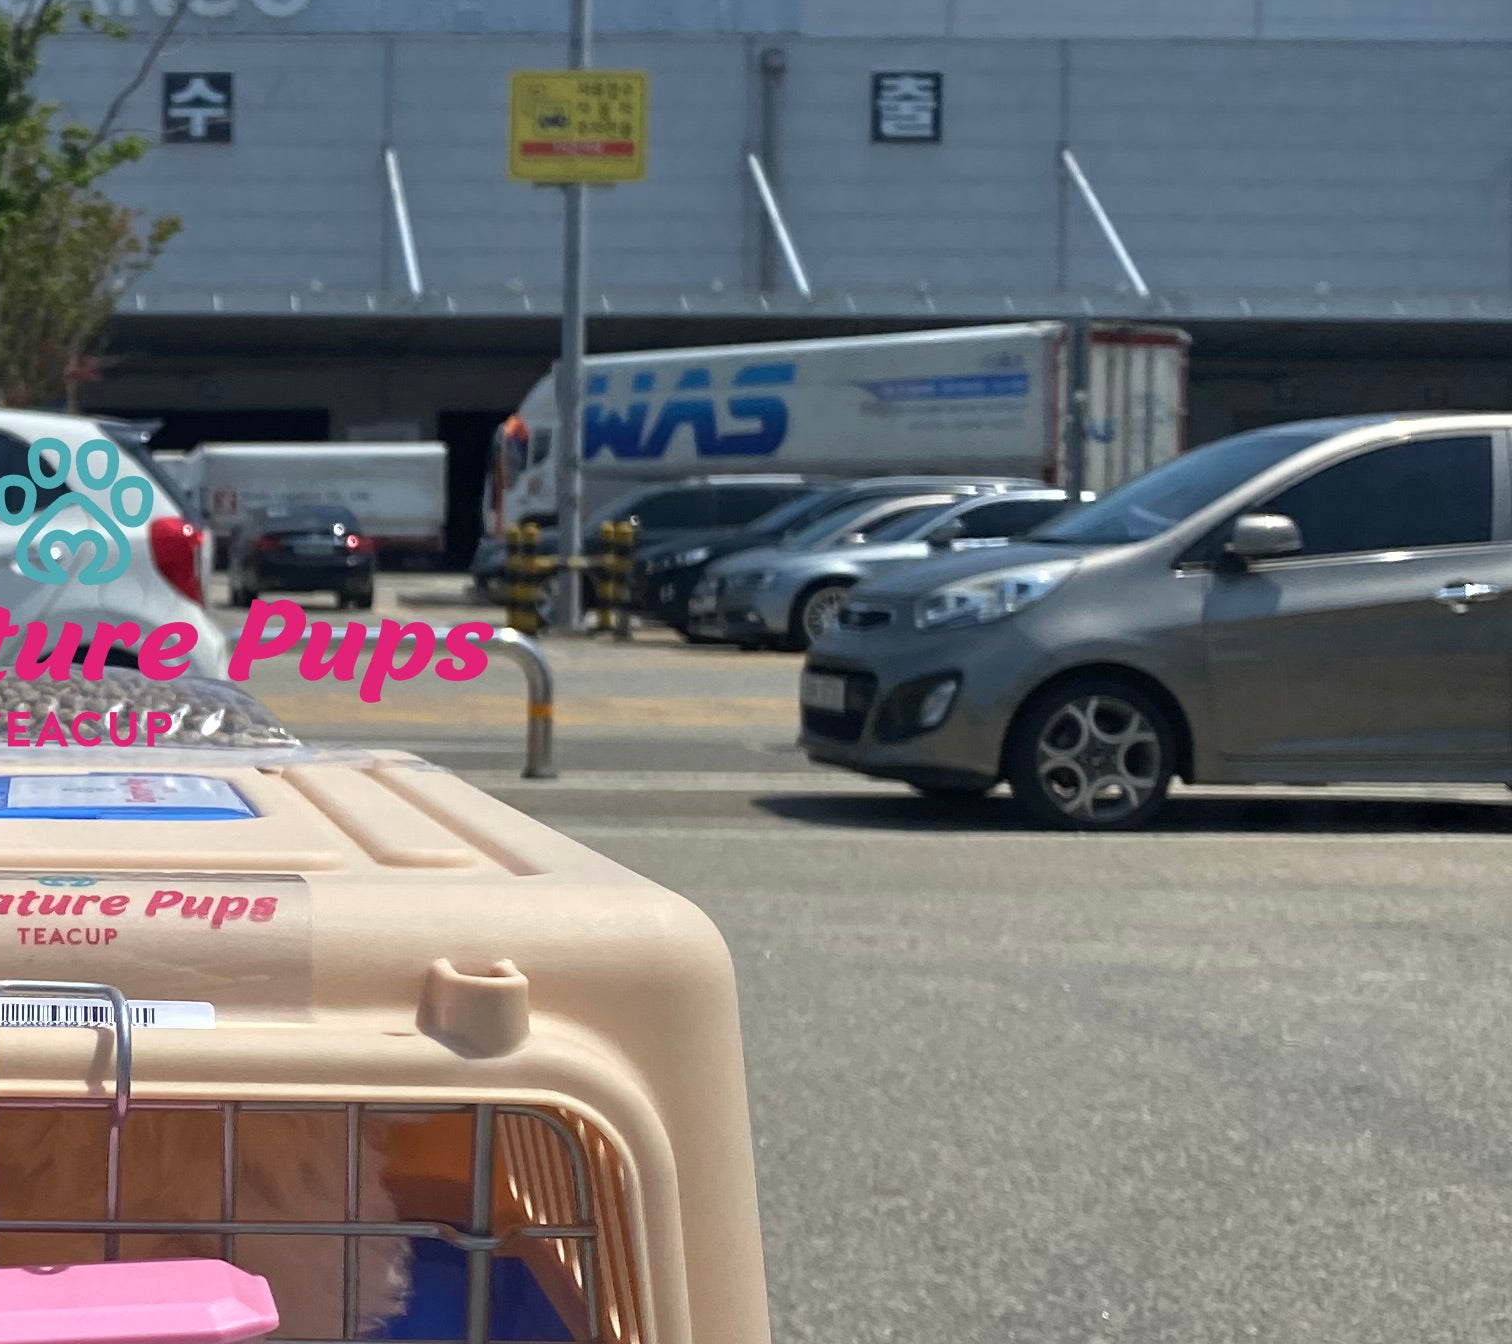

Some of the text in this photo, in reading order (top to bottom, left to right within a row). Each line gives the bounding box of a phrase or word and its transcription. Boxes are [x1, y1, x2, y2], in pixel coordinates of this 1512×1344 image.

[168, 78, 226, 136] 수
[583, 363, 797, 461] WAS
[145, 889, 279, 929] Pups
[17, 927, 119, 946] TEACUP
